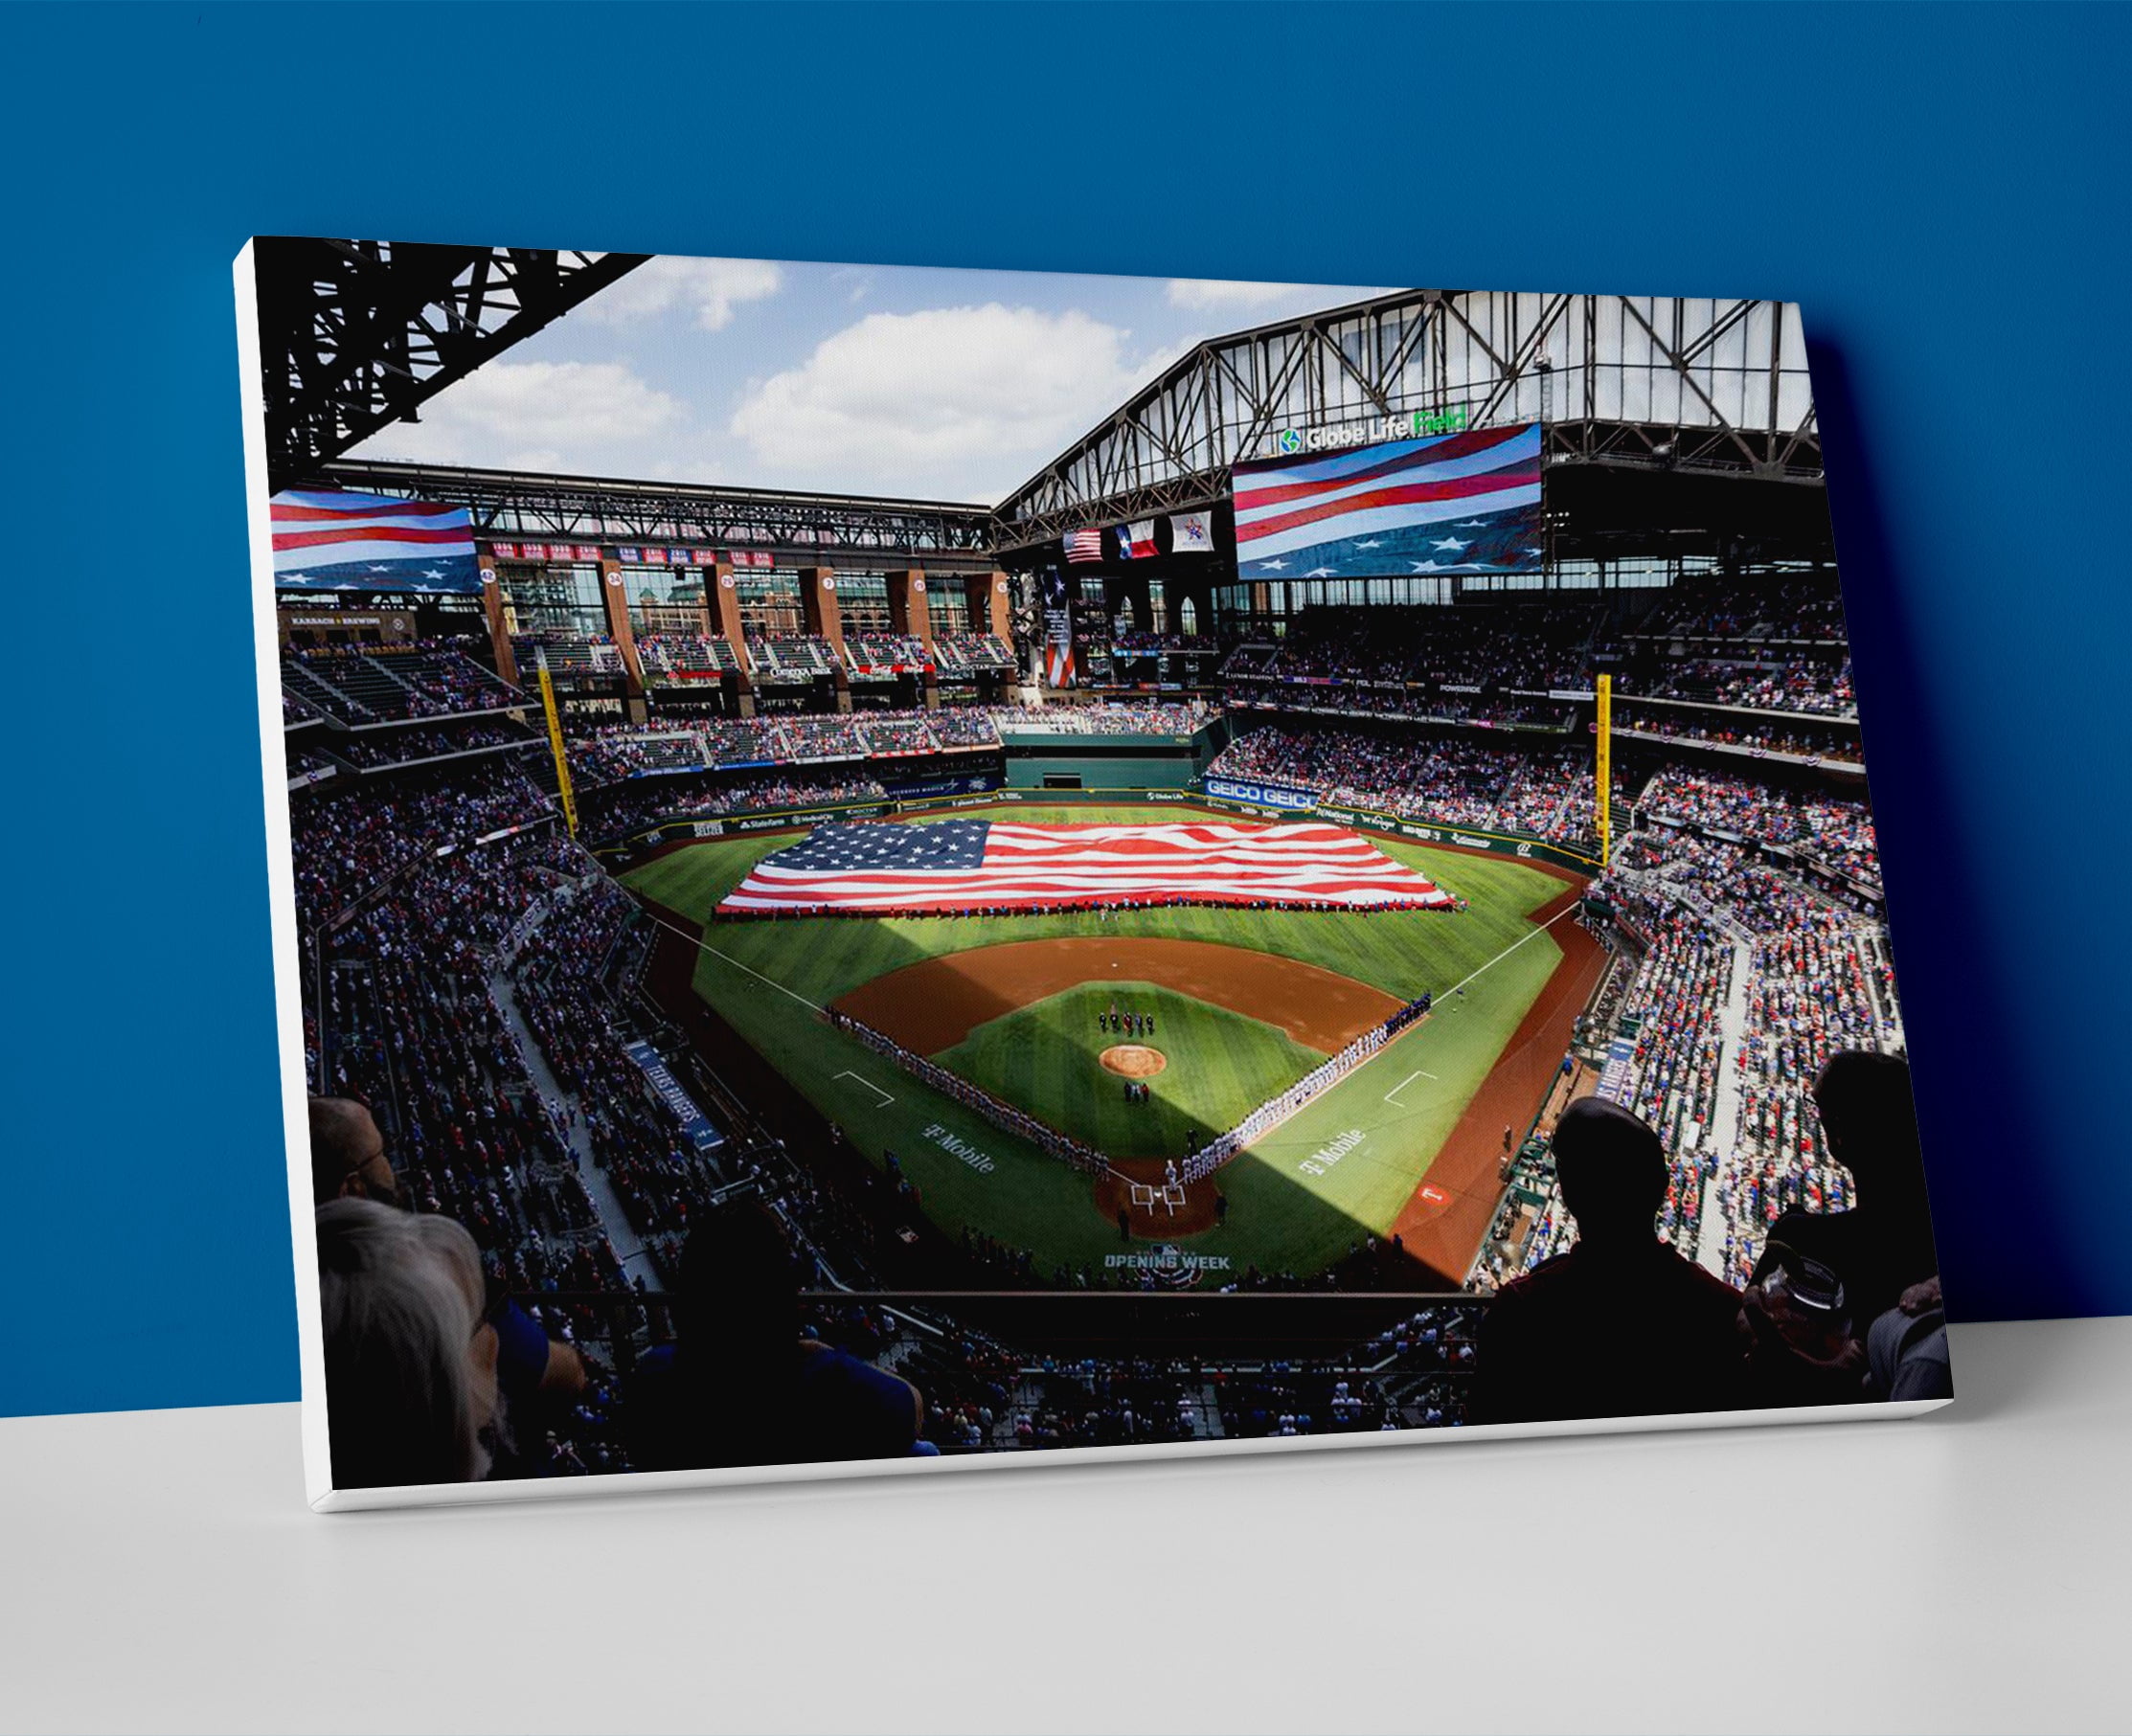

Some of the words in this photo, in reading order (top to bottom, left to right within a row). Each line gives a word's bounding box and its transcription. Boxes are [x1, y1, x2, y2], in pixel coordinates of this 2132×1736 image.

[1306, 426, 1366, 449] Globe
[1370, 416, 1409, 440] Life
[1413, 400, 1466, 434] Field
[342, 617, 380, 625] BREWING
[1440, 684, 1483, 694] POWERADE
[1207, 779, 1260, 801] GEICO
[1104, 1253, 1178, 1270] OPENING
[1182, 1255, 1231, 1271] WEEK
